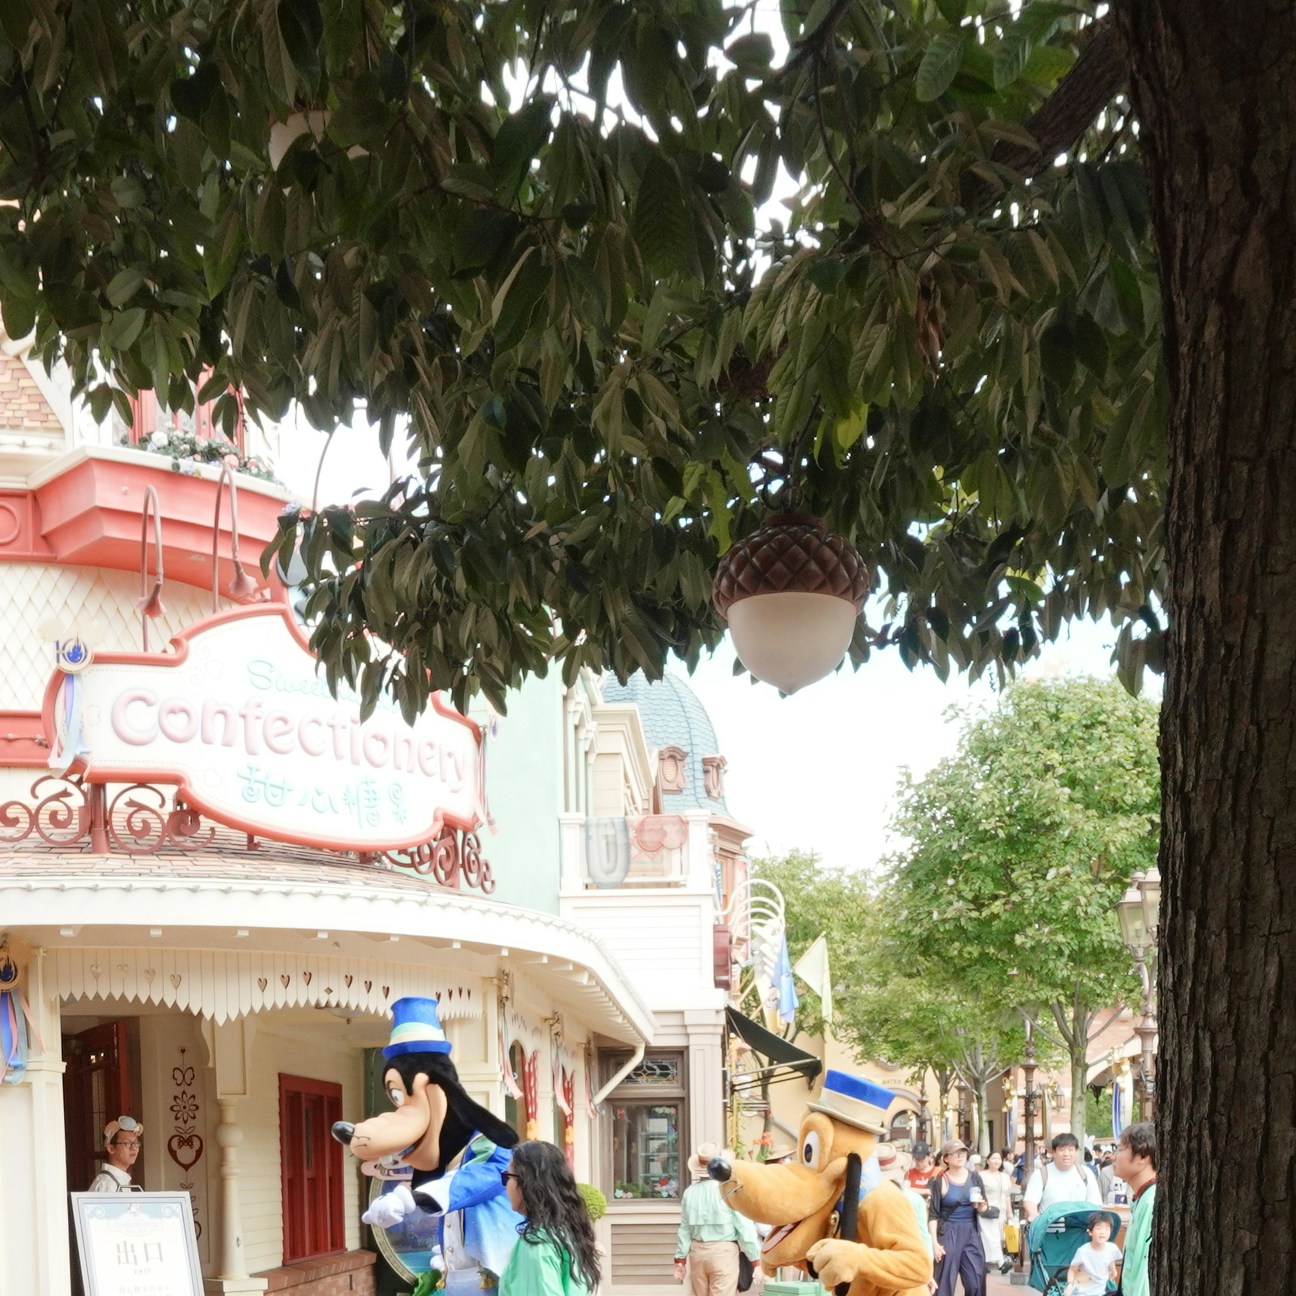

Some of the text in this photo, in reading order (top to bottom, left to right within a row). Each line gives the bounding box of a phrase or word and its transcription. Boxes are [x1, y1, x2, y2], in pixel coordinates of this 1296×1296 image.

[110, 687, 466, 794] Confectionery
[236, 762, 408, 829] 甜心糖果
[117, 1241, 163, 1265] 出口
[134, 1267, 151, 1276] EXIT
